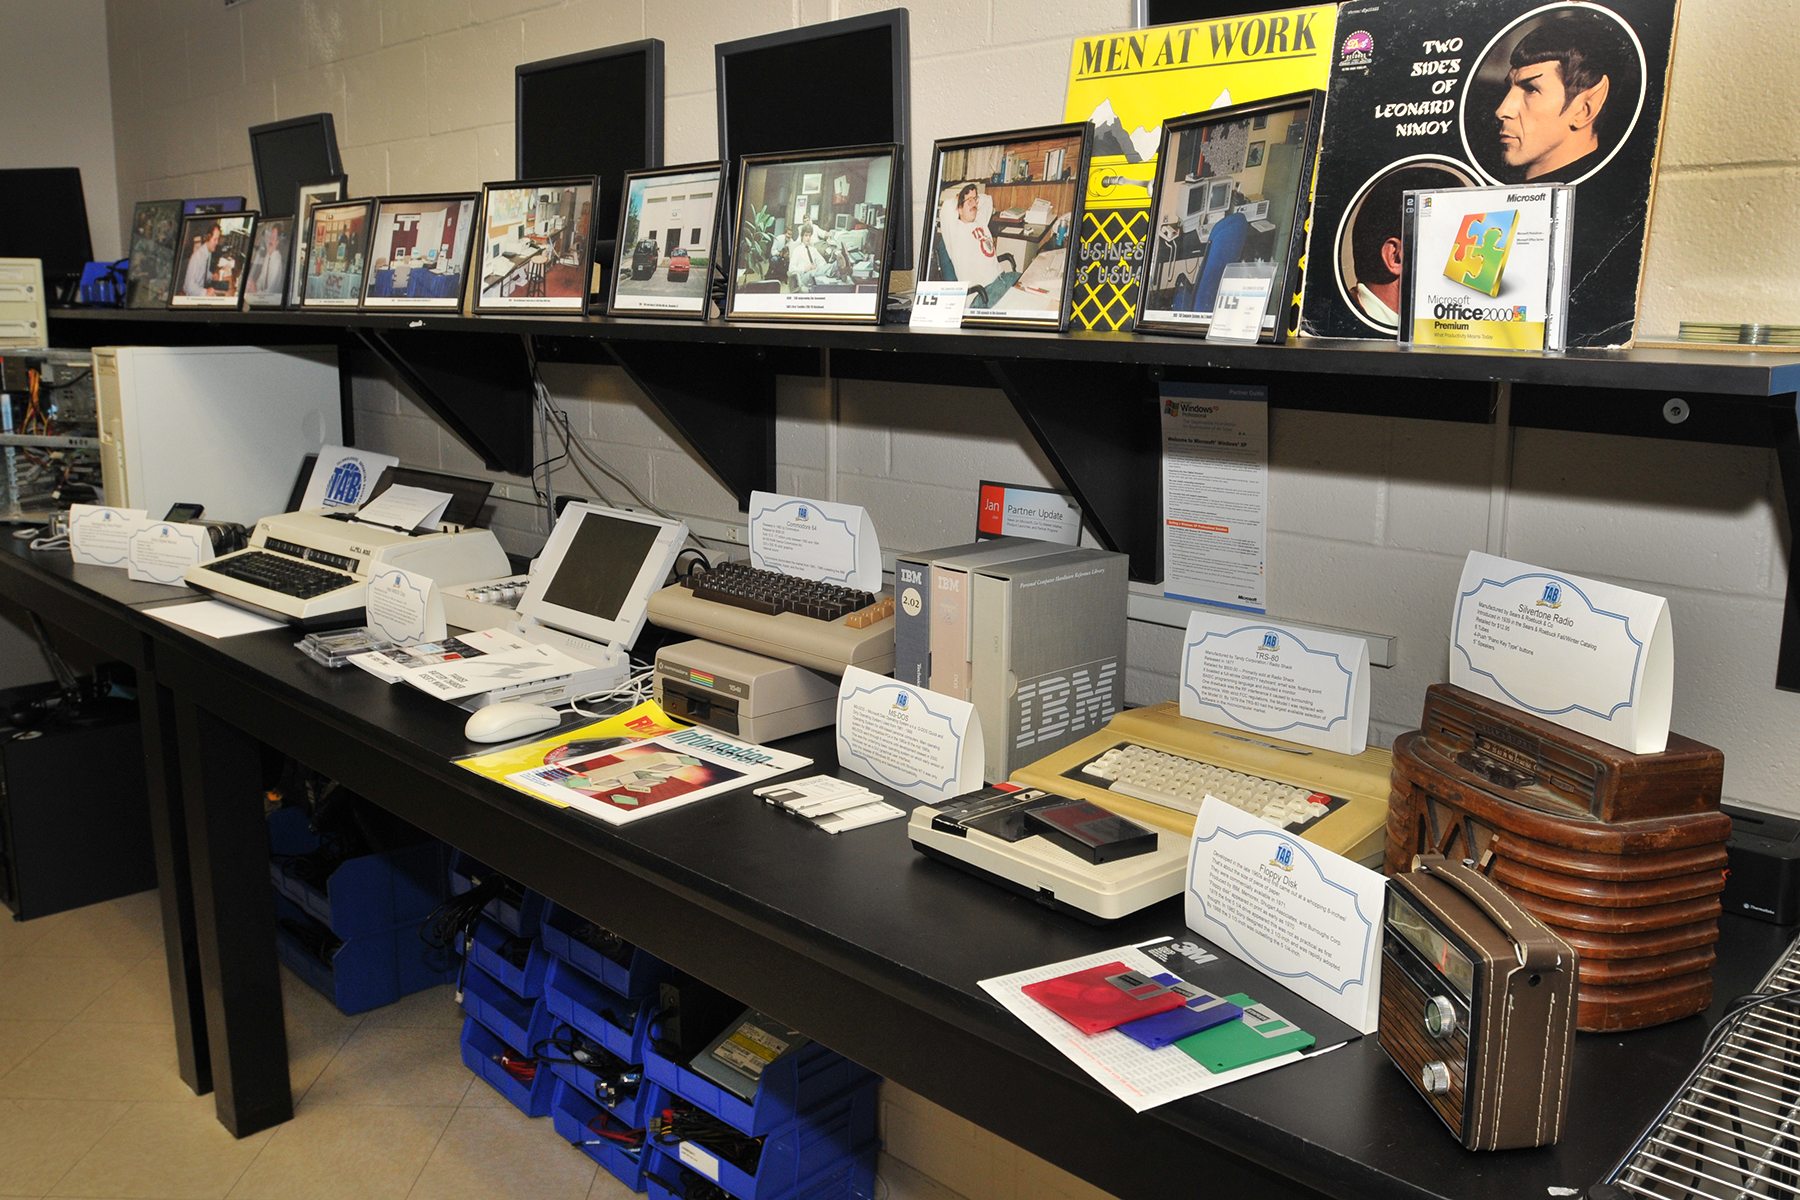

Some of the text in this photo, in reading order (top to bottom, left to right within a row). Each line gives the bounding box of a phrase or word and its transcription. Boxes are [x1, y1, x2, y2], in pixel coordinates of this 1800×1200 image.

[1078, 12, 1319, 75] MEN AT WORK
[1423, 37, 1464, 54] TWO
[1410, 58, 1462, 76] SIDES
[1432, 79, 1458, 94] OF
[1375, 99, 1454, 118] LEONARD
[1396, 120, 1452, 137] NIMOY
[1506, 192, 1546, 203] Microsoft
[1080, 241, 1144, 260] USINES
[1078, 265, 1141, 284] S USUA
[1428, 295, 1470, 304] Microsoft
[1434, 321, 1469, 330] Premium
[1181, 404, 1212, 414] Windows
[328, 467, 362, 503] TAB
[985, 498, 999, 511] Jan
[1007, 504, 1063, 520] Partner Update
[787, 521, 810, 530] Commodore
[901, 569, 922, 585] IBM
[938, 576, 959, 592] IBM
[1020, 579, 1036, 589] Personal
[1037, 577, 1054, 586] Computer
[1055, 573, 1074, 582] Hardware
[1092, 568, 1105, 577] Library
[1543, 585, 1559, 602] TAB
[903, 596, 920, 608] 2.02
[1475, 616, 1490, 625] Retailed
[1478, 601, 1503, 613] Manufactured
[1509, 610, 1520, 618] Sears
[1525, 615, 1542, 624] Roebuck
[1517, 602, 1574, 627] Silvertone Radio
[1477, 624, 1489, 633] Tubes
[1264, 635, 1277, 647] TAB
[1476, 639, 1495, 651] Speakers
[1255, 651, 1279, 662] TRS-80
[1518, 645, 1533, 655] buttons
[664, 665, 688, 676] commodore
[1016, 662, 1117, 749] IBM
[888, 709, 909, 722] MS-DOS
[1277, 845, 1292, 864] TAB
[1258, 863, 1298, 890] Floppy Disk
[1170, 941, 1219, 964] 3M
